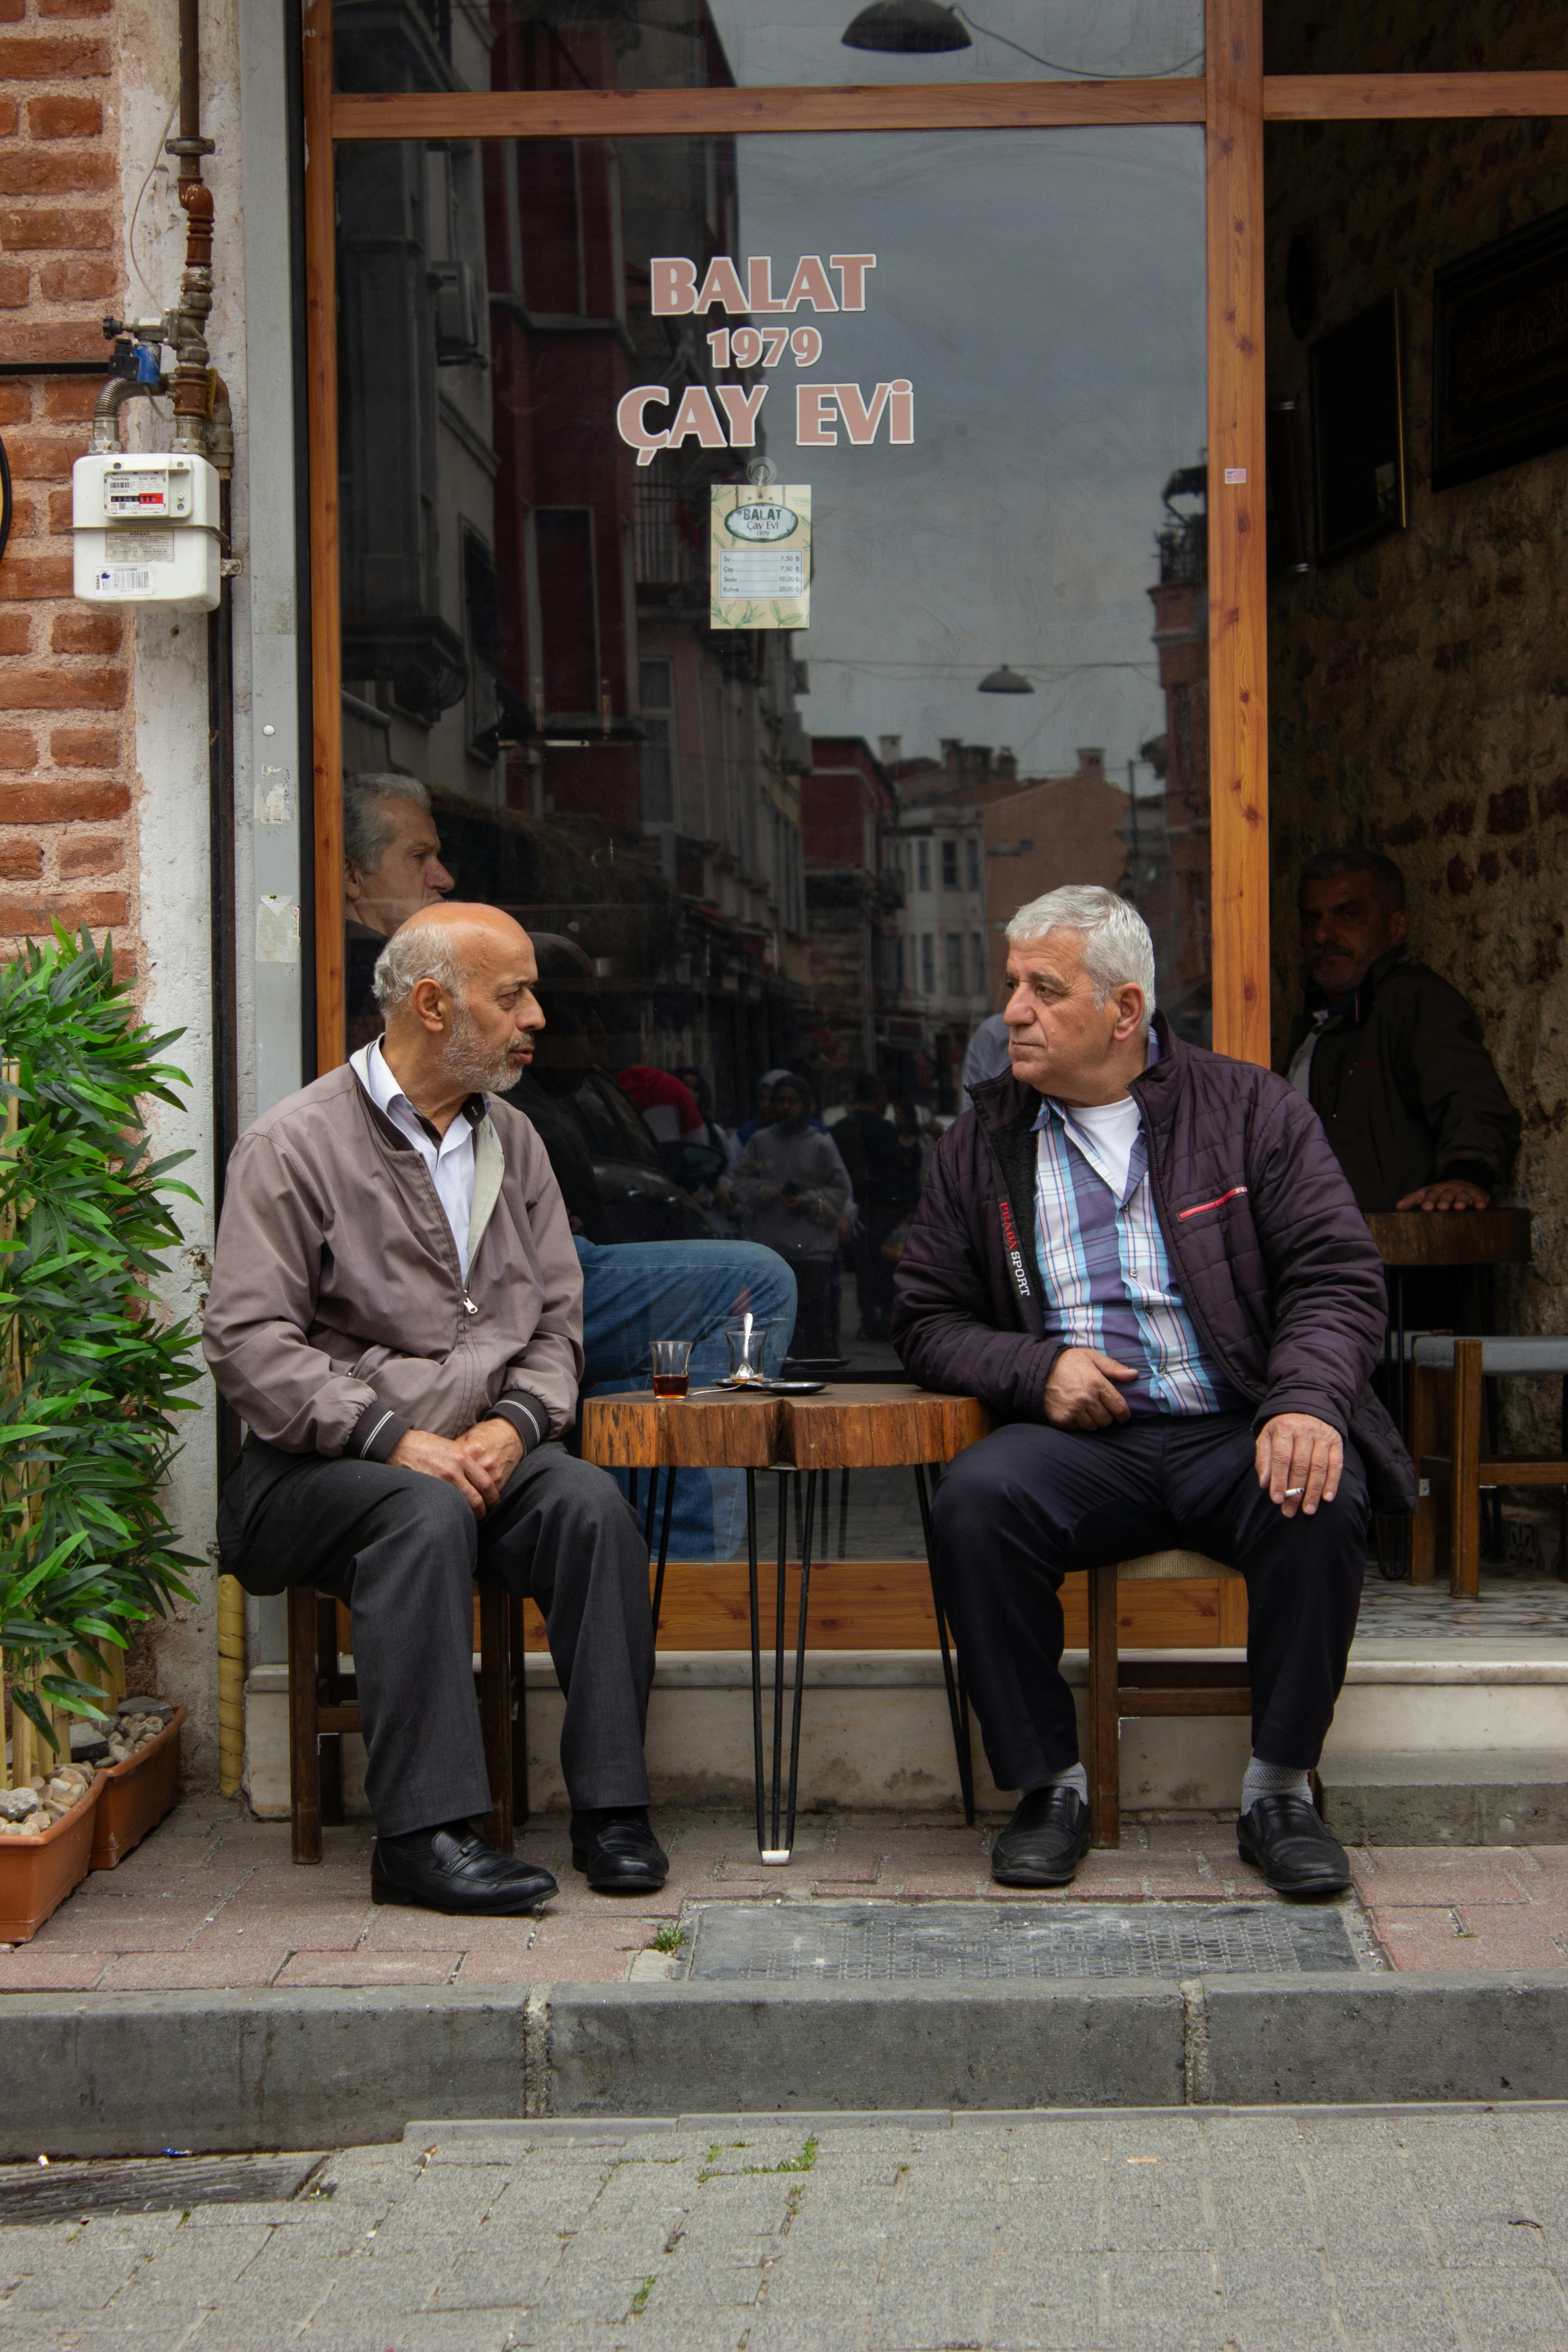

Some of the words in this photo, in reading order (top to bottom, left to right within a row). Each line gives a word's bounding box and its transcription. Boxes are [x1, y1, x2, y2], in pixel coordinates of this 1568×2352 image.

[651, 254, 877, 315] BALAT
[707, 326, 823, 368] 1979
[617, 384, 769, 466] ÇAY
[743, 508, 782, 520] BALAT
[747, 521, 763, 532] Çay
[999, 1201, 1017, 1250] PRADA
[1010, 1251, 1031, 1296] SPORT
